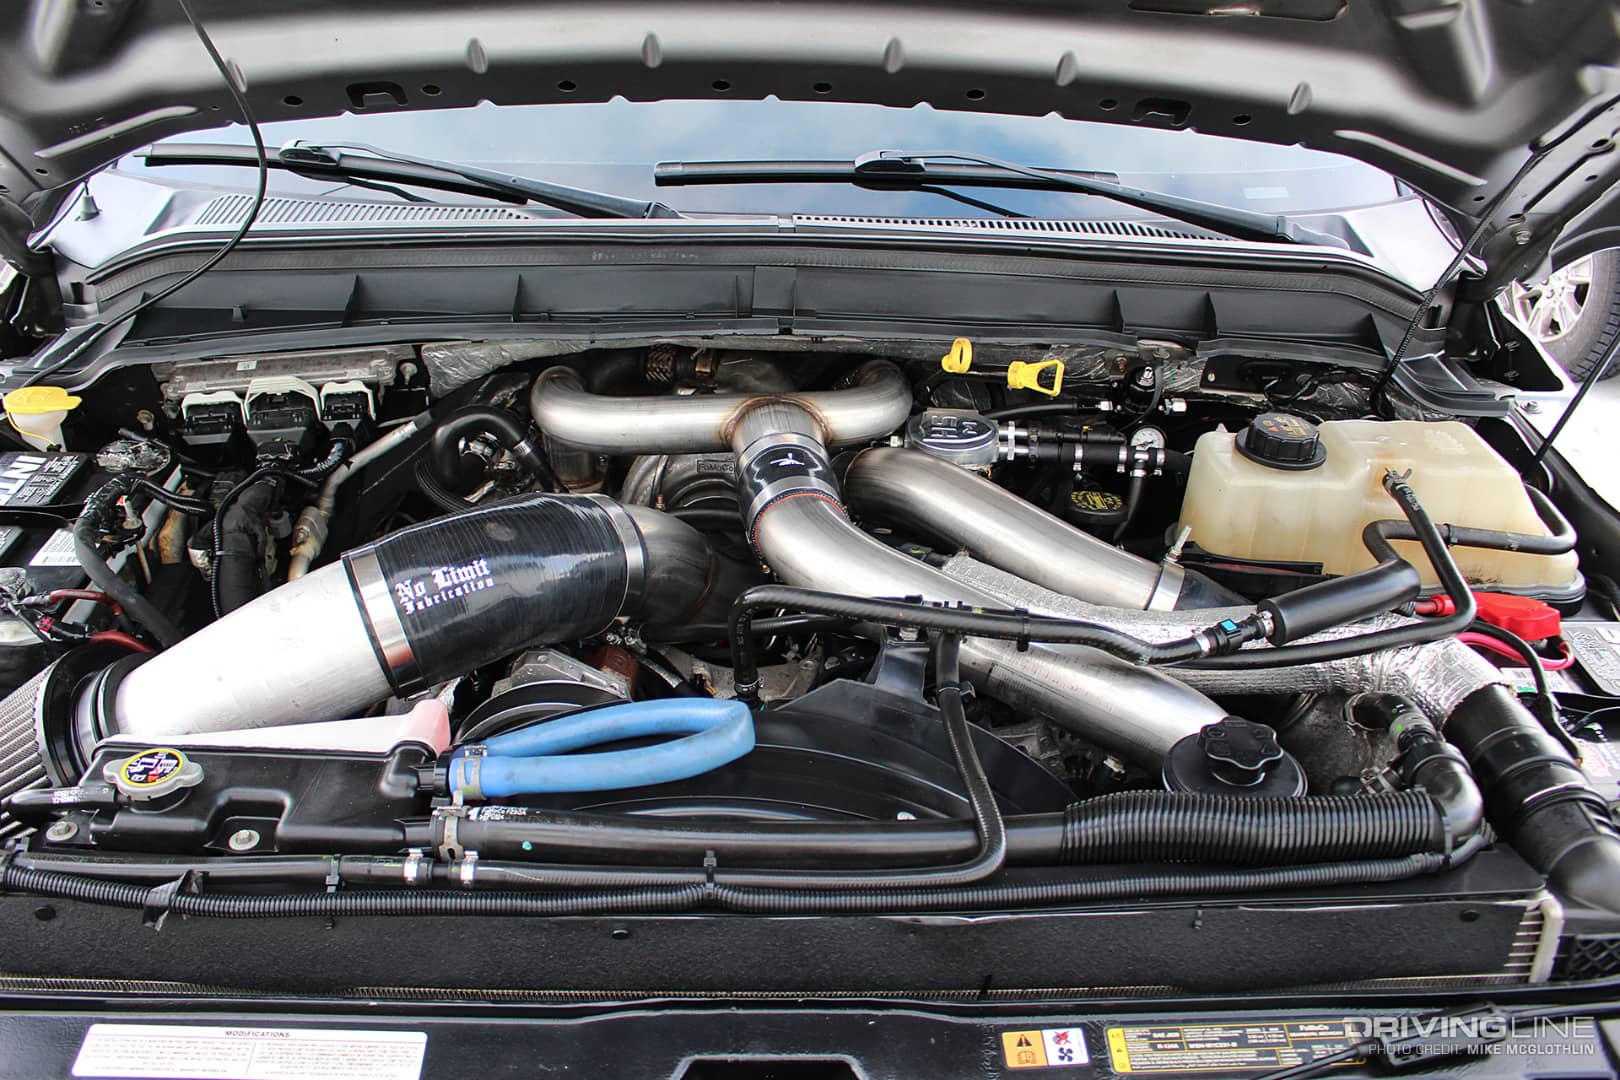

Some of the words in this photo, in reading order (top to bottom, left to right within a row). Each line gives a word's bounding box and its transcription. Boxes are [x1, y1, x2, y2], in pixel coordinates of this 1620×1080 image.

[698, 461, 734, 472] FoMoCo
[395, 578, 427, 604] No
[432, 558, 490, 590] Limit
[403, 577, 495, 615] Fabrication
[224, 1030, 290, 1038] MODIFICATIONS
